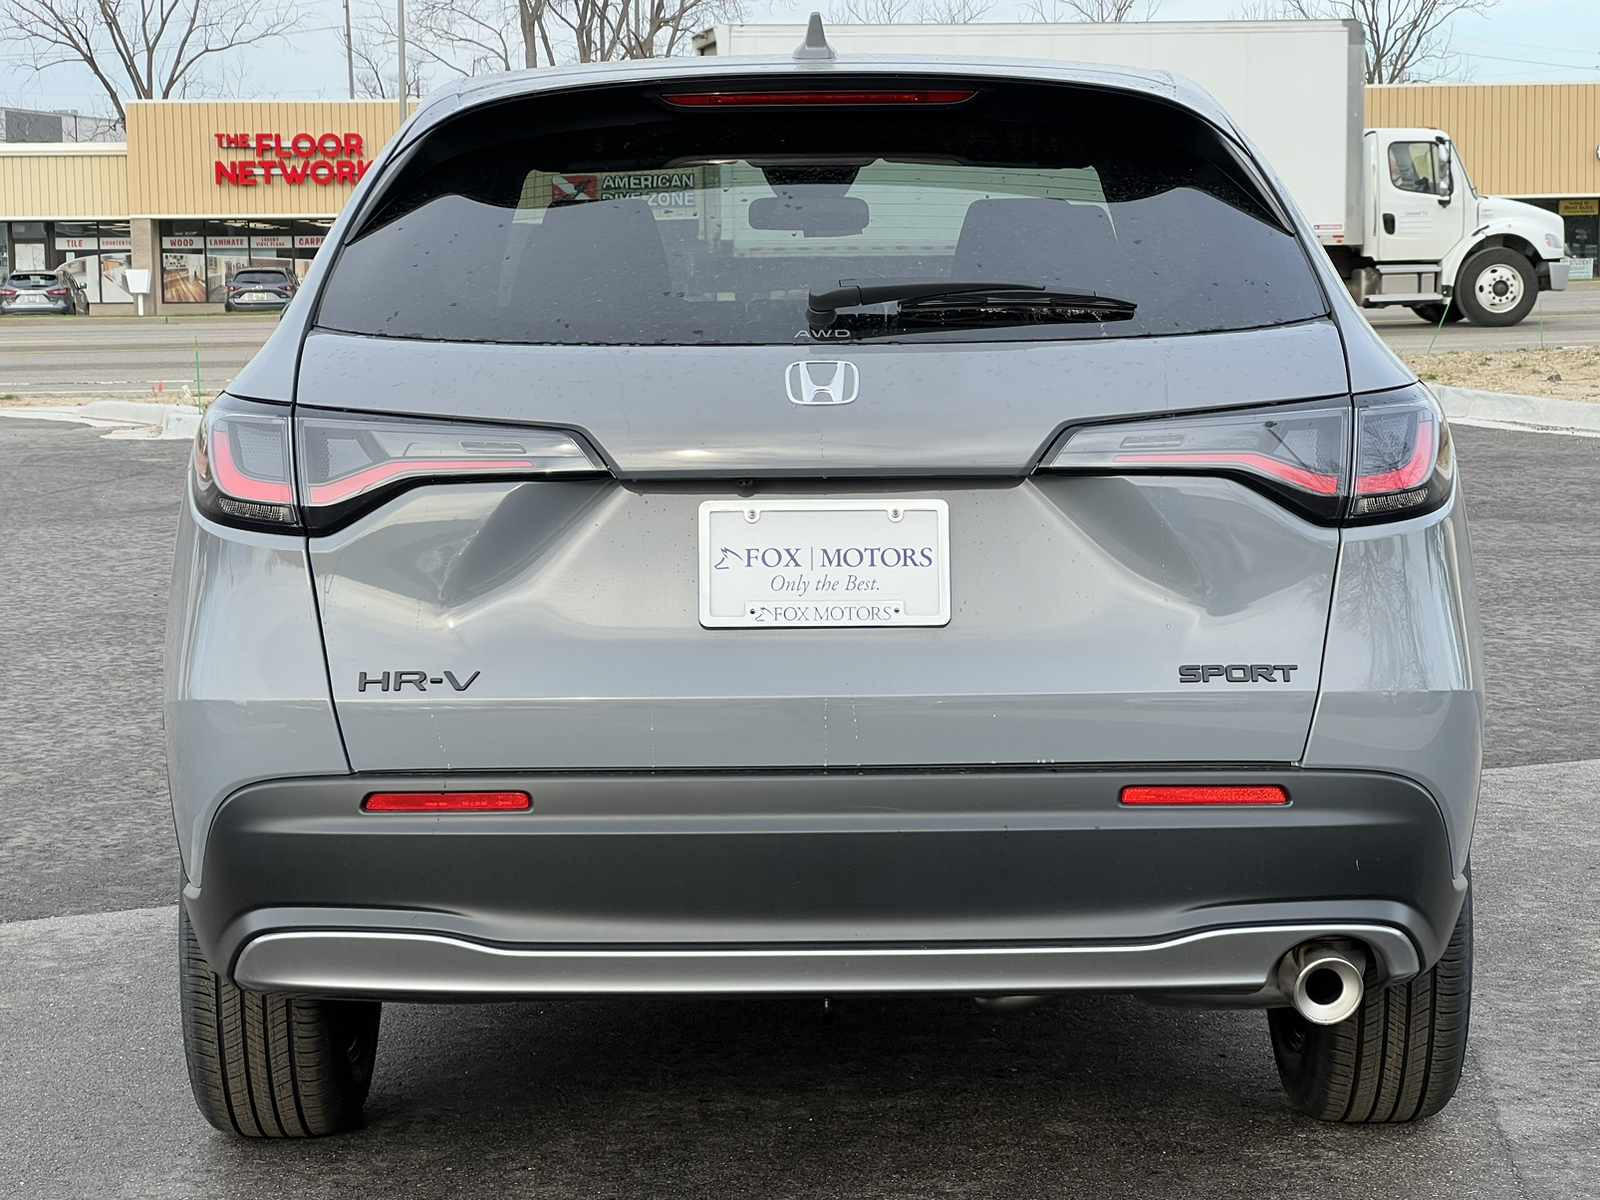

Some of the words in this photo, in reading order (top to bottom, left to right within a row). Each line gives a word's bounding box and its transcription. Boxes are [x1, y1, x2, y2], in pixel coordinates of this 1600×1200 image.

[214, 133, 250, 148] THE
[255, 133, 363, 158] FLOOR
[602, 174, 695, 190] AMERICAN
[647, 191, 695, 206] ZONE
[66, 240, 83, 248] TILE
[170, 239, 194, 247] WOOD
[209, 238, 244, 246] LAMINATE
[794, 329, 850, 338] AWD
[744, 547, 801, 568] FOX
[820, 547, 933, 568] MOTORS
[770, 574, 810, 596] Only
[815, 574, 839, 591] the
[845, 574, 880, 591] Best.
[774, 606, 809, 621] FOX
[813, 606, 891, 621] MOTORS
[358, 670, 481, 692] HR-V
[1178, 664, 1298, 683] SPORT
